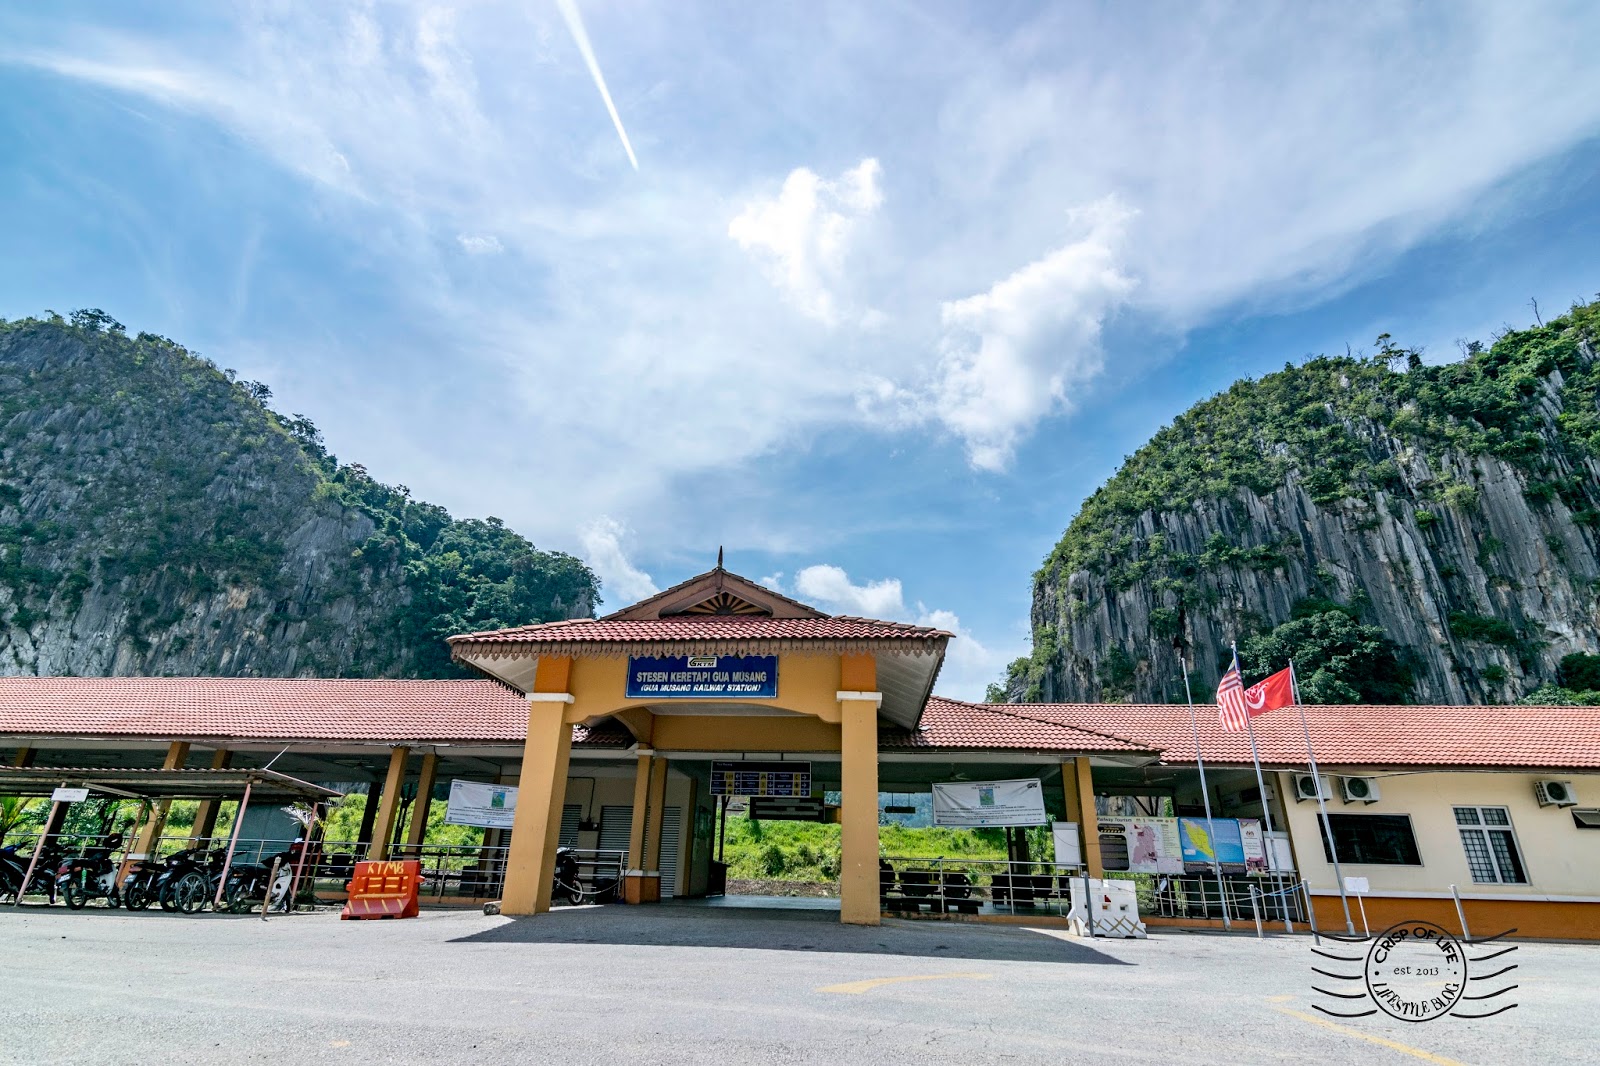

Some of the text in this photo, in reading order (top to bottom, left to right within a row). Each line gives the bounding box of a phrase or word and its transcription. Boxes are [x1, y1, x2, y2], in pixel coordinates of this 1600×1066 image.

[636, 671, 767, 682] STESEN KERETAPI GUA MUSANG
[641, 684, 761, 692] (GUA MUSANG RAILWAY STATION)
[367, 862, 405, 875] KTMB
